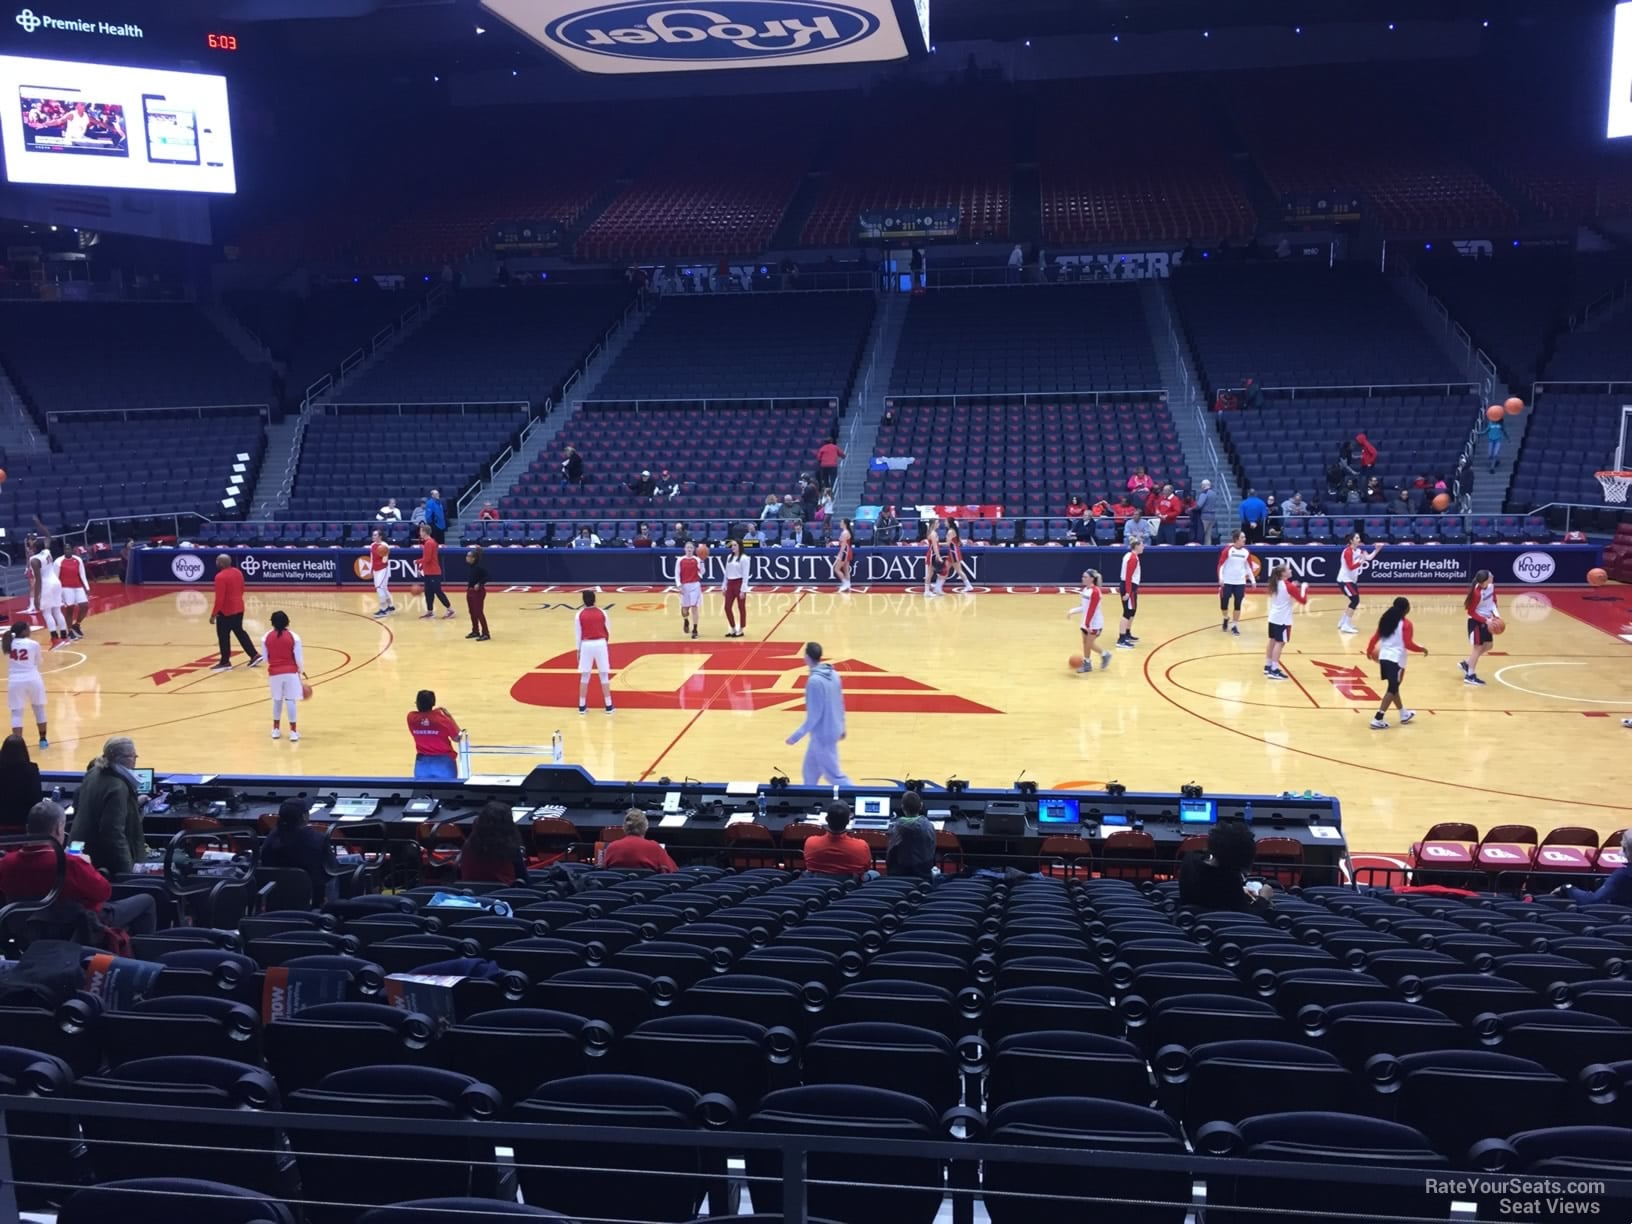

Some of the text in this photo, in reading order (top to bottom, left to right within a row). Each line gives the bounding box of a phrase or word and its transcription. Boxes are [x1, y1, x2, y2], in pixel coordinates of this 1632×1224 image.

[42, 15, 144, 38] Premier Health
[586, 8, 841, 52] Kroger
[207, 34, 238, 50] 6:03
[175, 558, 201, 578] Kroger
[262, 559, 337, 571] Premier Health
[660, 555, 839, 581] UIVRSITY
[1371, 559, 1460, 571] Premier Health
[1517, 556, 1552, 579] Kroger
[262, 571, 334, 580] Miami Valley Hospital
[1371, 570, 1467, 580] Good Samaritan Hospital
[9, 648, 29, 661] 42
